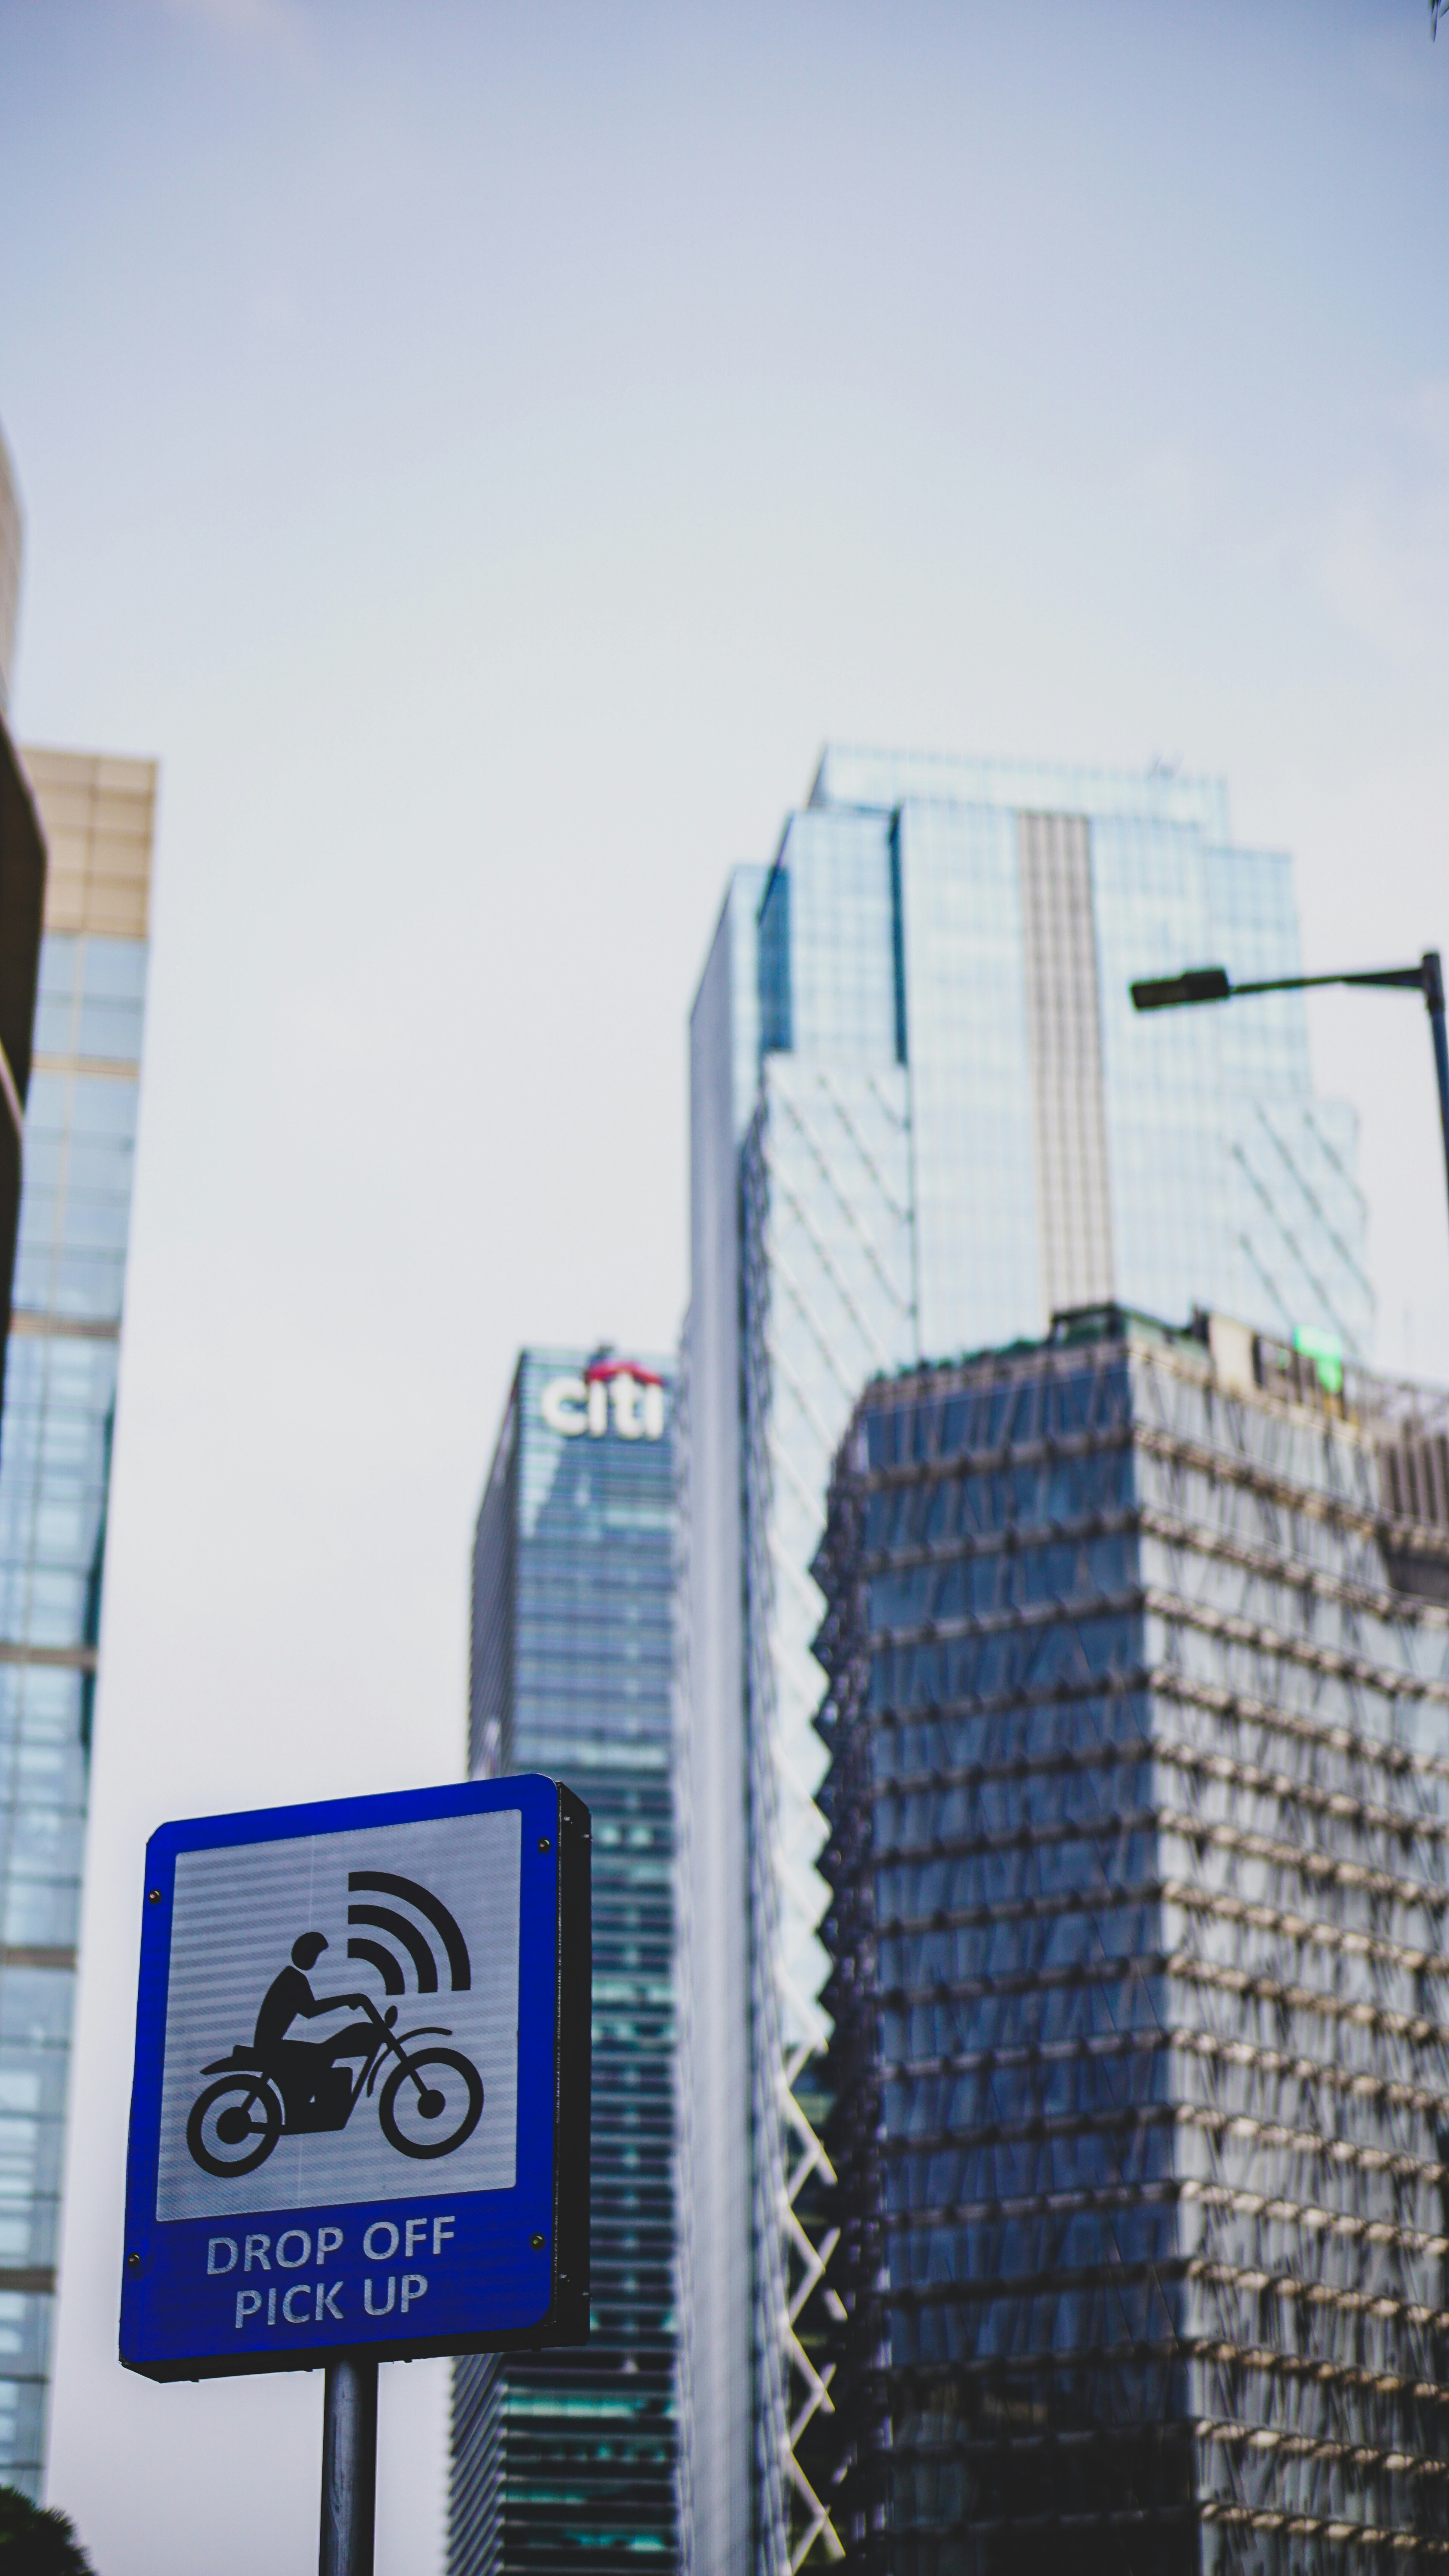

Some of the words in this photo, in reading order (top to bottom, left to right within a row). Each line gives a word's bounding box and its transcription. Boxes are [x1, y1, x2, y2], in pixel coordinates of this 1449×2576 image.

[542, 1365, 663, 1441] citi
[206, 2227, 343, 2275] DROP
[363, 2215, 455, 2260] OFF
[234, 2281, 344, 2328] PICK
[364, 2274, 428, 2316] UP
